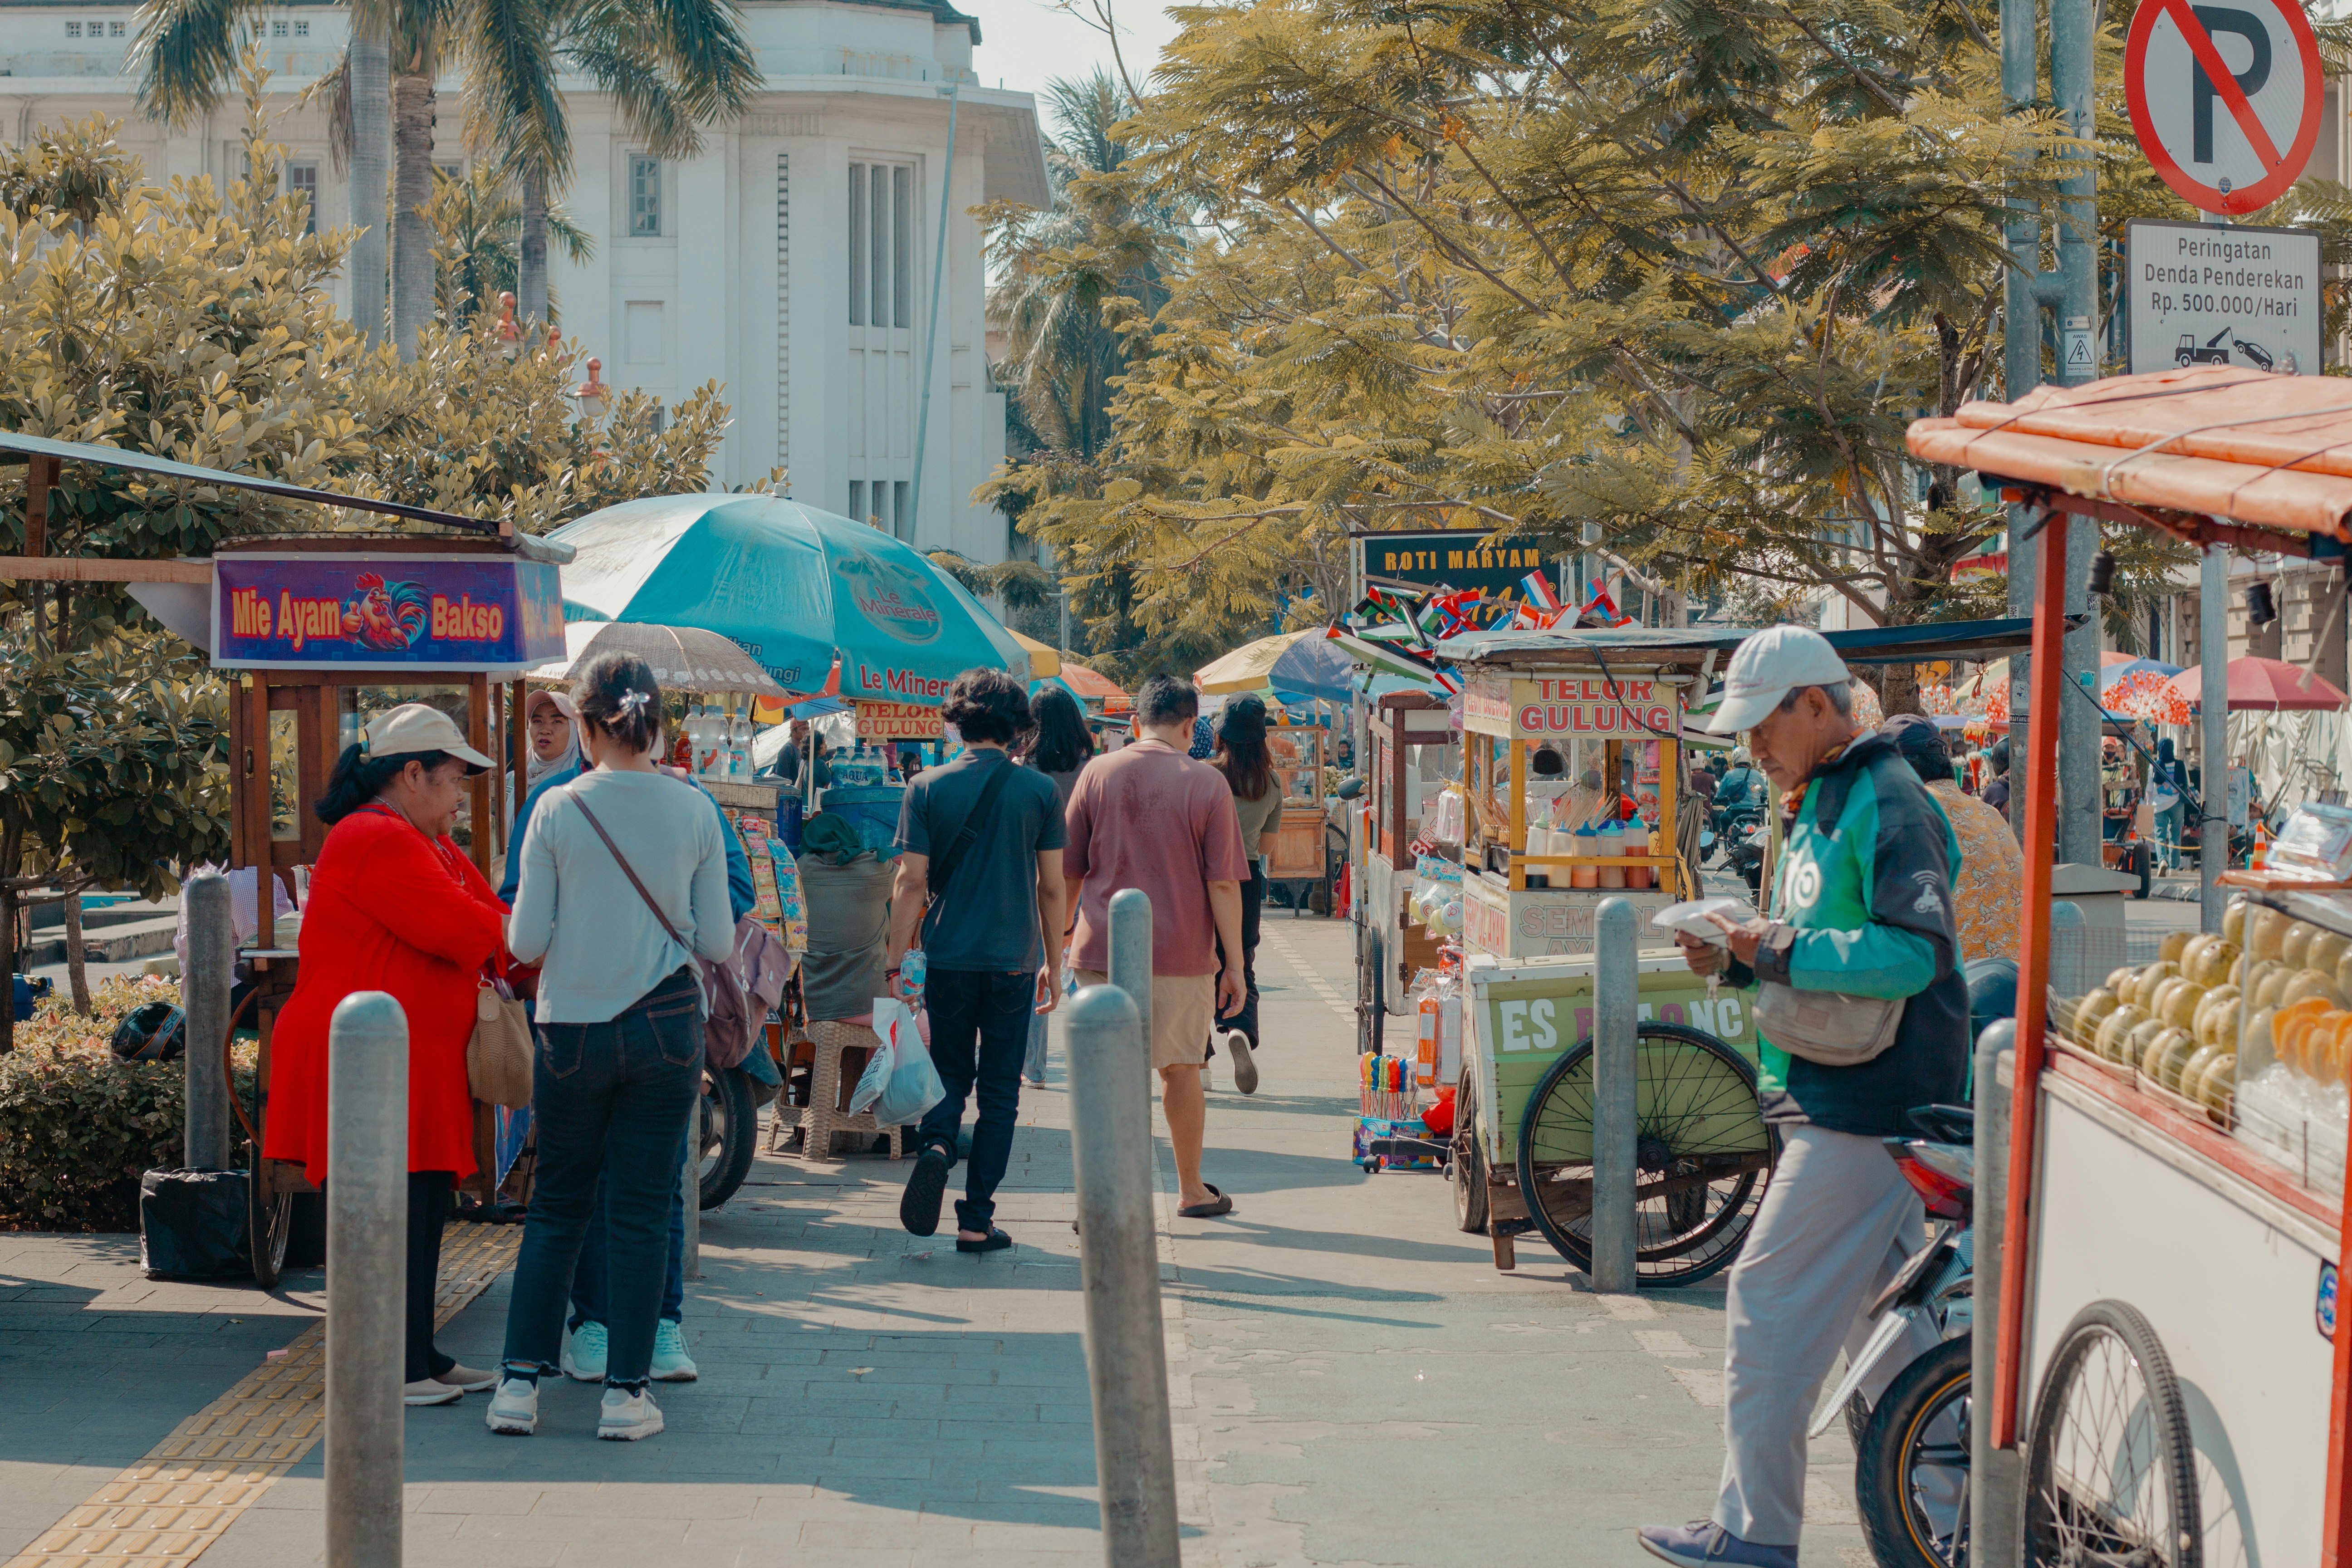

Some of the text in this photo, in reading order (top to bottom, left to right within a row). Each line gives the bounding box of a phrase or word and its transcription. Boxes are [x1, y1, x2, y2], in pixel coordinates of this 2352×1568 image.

[2178, 237, 2271, 263] Peringatan
[2146, 264, 2303, 289] Denda Penderekan
[2152, 293, 2297, 317] Rp. 500.000/Hari
[1385, 548, 1539, 570] ROTI MARYAM
[875, 586, 902, 605] Le
[231, 587, 271, 639] Mie
[276, 587, 341, 652] Ayam
[431, 593, 503, 642] Bakso
[858, 596, 938, 622] Minerale
[2009, 606, 2017, 618] 3466
[860, 665, 953, 697] Le Miner
[1536, 680, 1655, 703] TELOR
[862, 704, 937, 718] TELOR
[1518, 704, 1672, 733] GULUNG
[857, 720, 942, 735] GULUNG
[842, 770, 868, 783] AQUA
[1499, 999, 1557, 1052] ES
